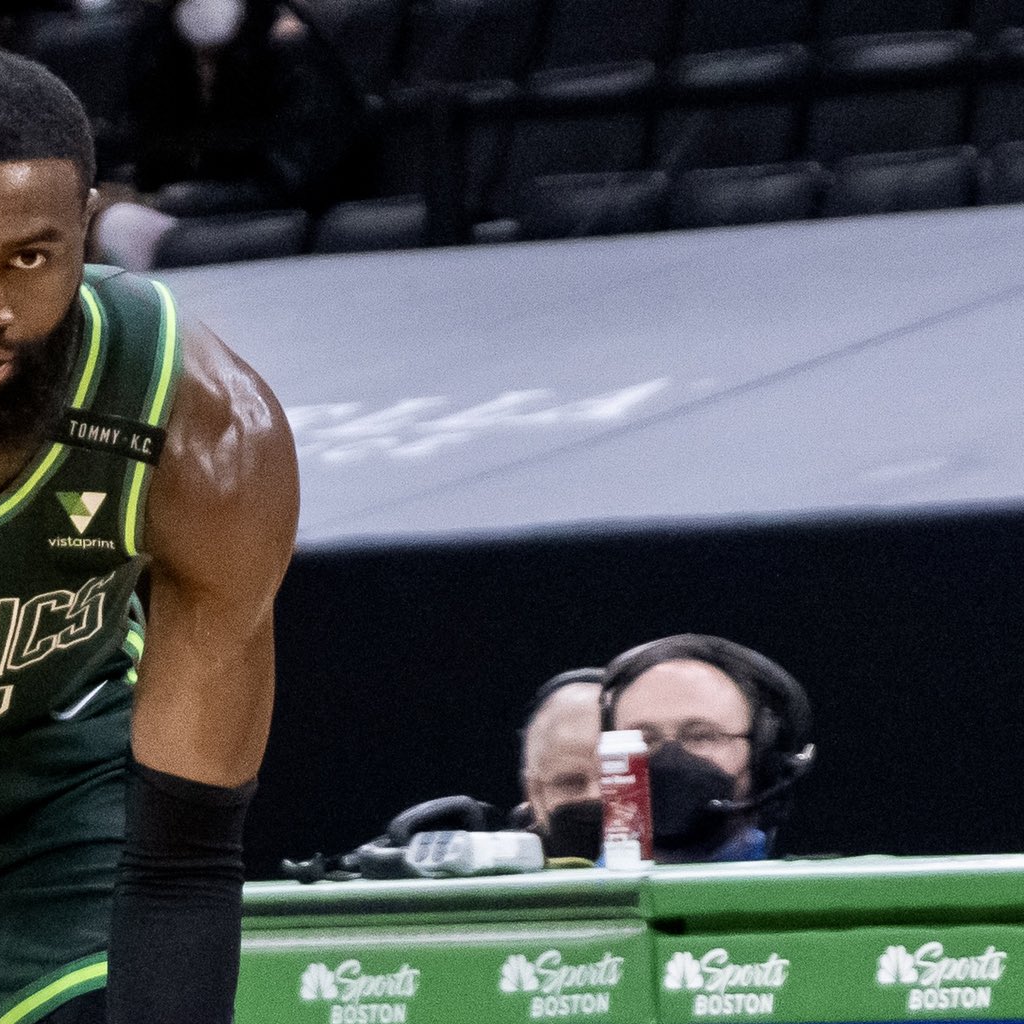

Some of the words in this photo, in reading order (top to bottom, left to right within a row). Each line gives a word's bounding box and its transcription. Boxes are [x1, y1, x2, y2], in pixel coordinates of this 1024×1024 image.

[70, 420, 120, 445] TOMMY
[48, 536, 116, 550] vistaprint
[535, 950, 624, 995] Sports
[700, 948, 790, 995] Sports
[915, 941, 1007, 990] Sports
[335, 959, 421, 1005] Sports
[530, 992, 610, 1019] BOSTON
[694, 992, 774, 1017] BOSTON
[908, 986, 992, 1011] BOSTON
